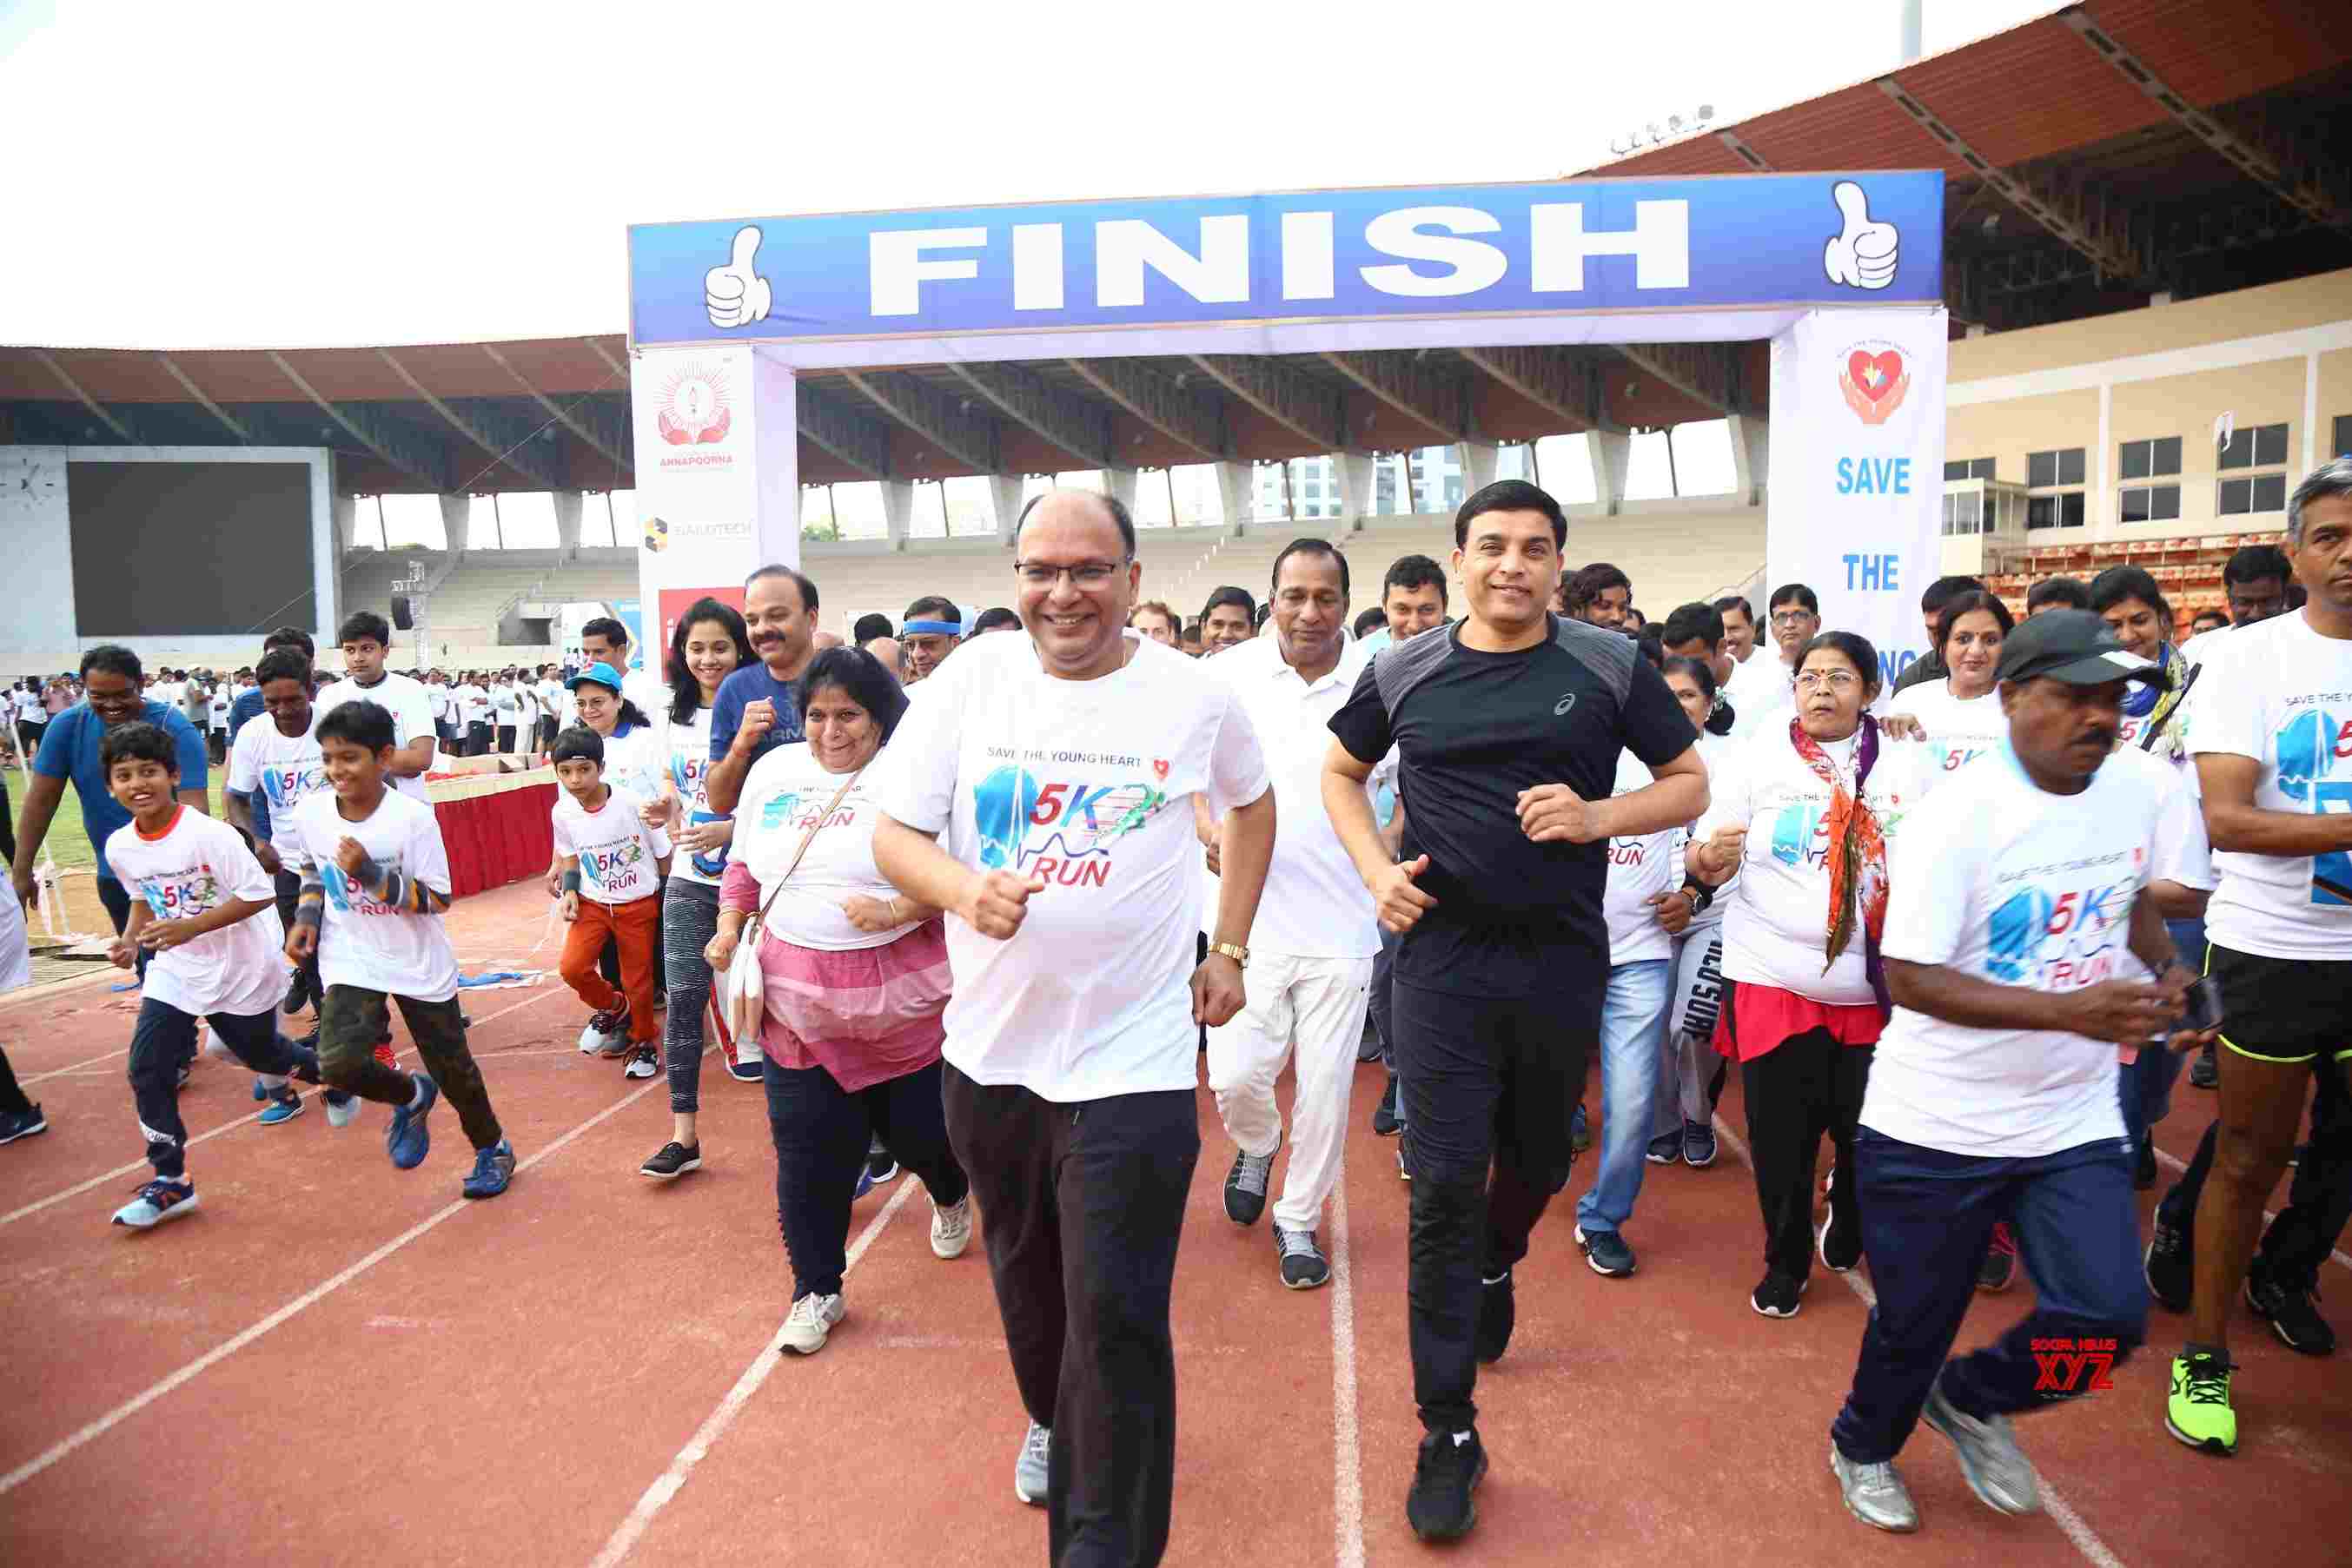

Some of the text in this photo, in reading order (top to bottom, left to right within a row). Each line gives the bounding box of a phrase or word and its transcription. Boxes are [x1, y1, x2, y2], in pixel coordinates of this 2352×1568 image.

[870, 200, 1689, 316] FINISH
[659, 454, 733, 466] ANNAPOORNA
[1836, 457, 1911, 494] SAVE
[1842, 553, 1899, 591] THE
[2319, 692, 2343, 702] THE
[987, 746, 1142, 767] SAVE THE YOUNG HEART
[1029, 784, 1114, 829] 5K
[799, 811, 855, 830] RUN
[599, 852, 624, 871] 5K
[1030, 857, 1112, 887] RUN
[609, 872, 638, 892] RUN
[2045, 889, 2113, 935] 5K
